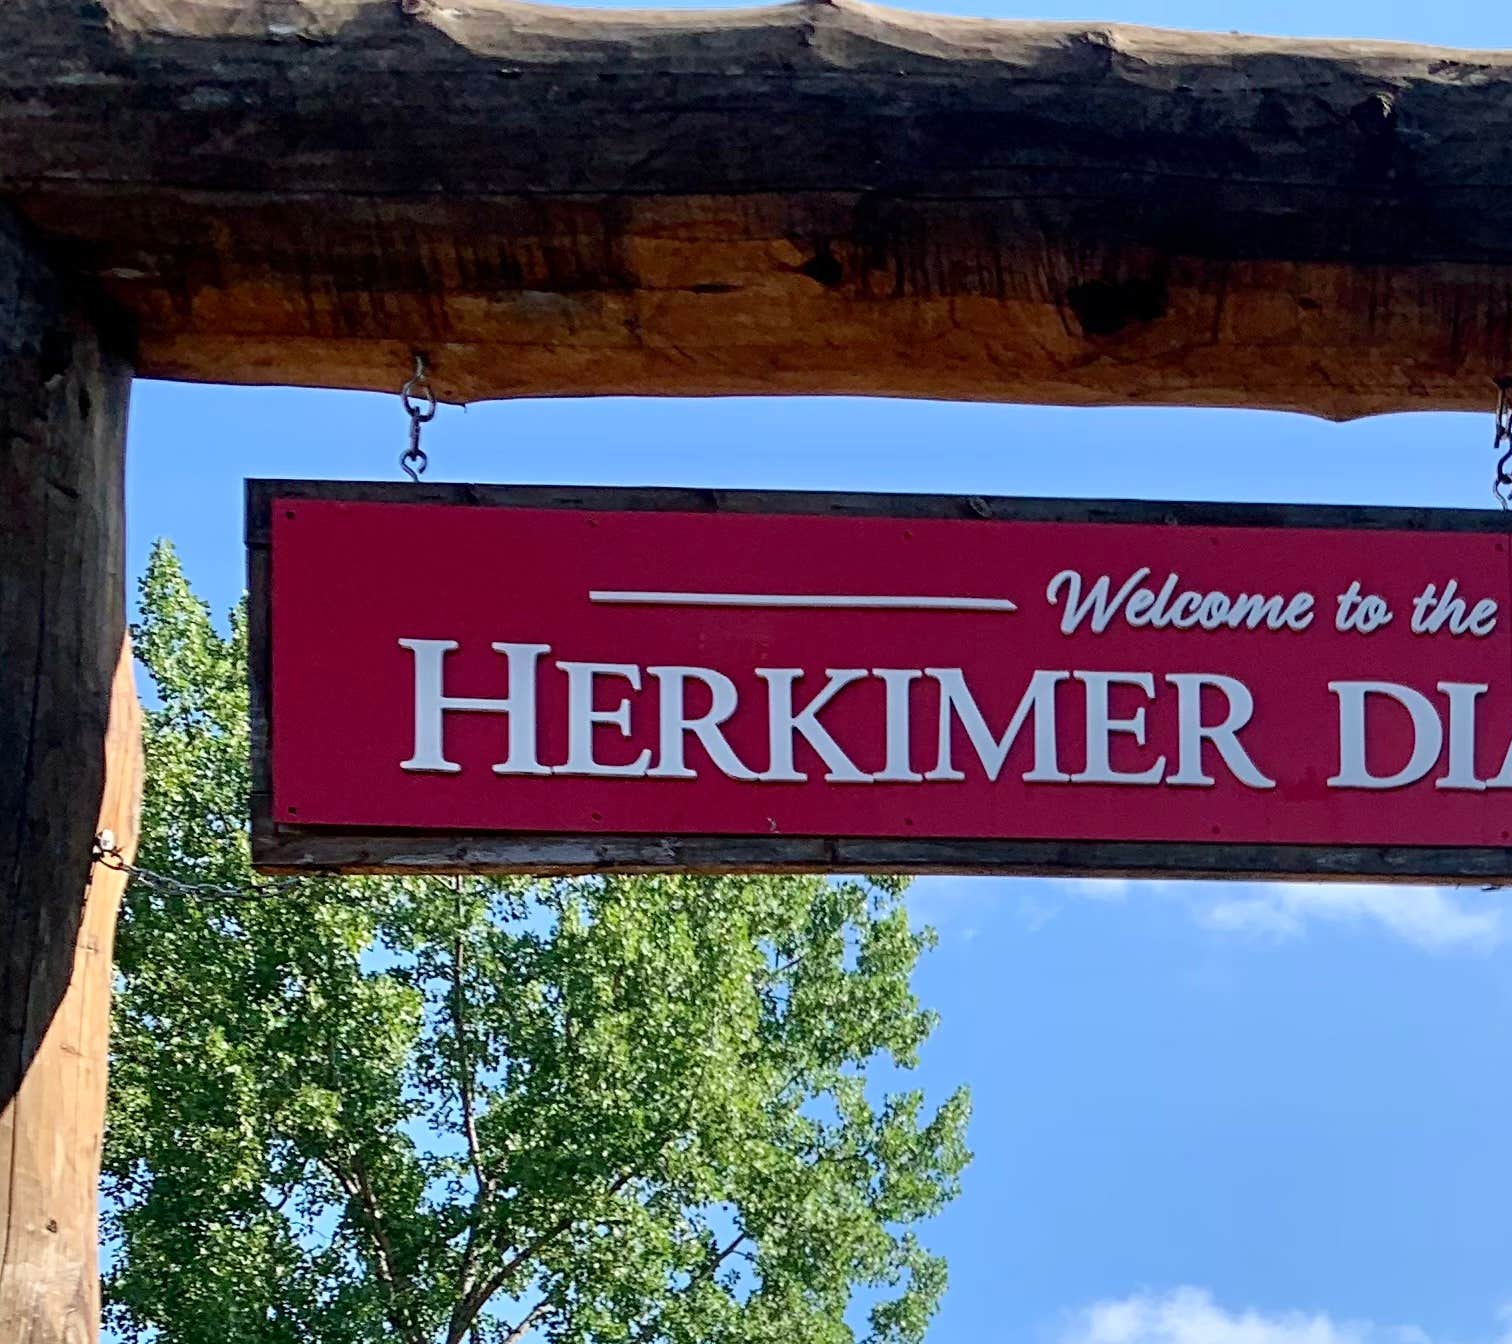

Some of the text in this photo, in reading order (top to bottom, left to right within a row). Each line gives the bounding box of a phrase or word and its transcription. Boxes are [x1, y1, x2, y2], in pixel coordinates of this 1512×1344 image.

[1045, 566, 1316, 636] Welcome
[1334, 580, 1395, 634] to
[1410, 577, 1499, 637] the
[398, 637, 1277, 789] HERKIMER
